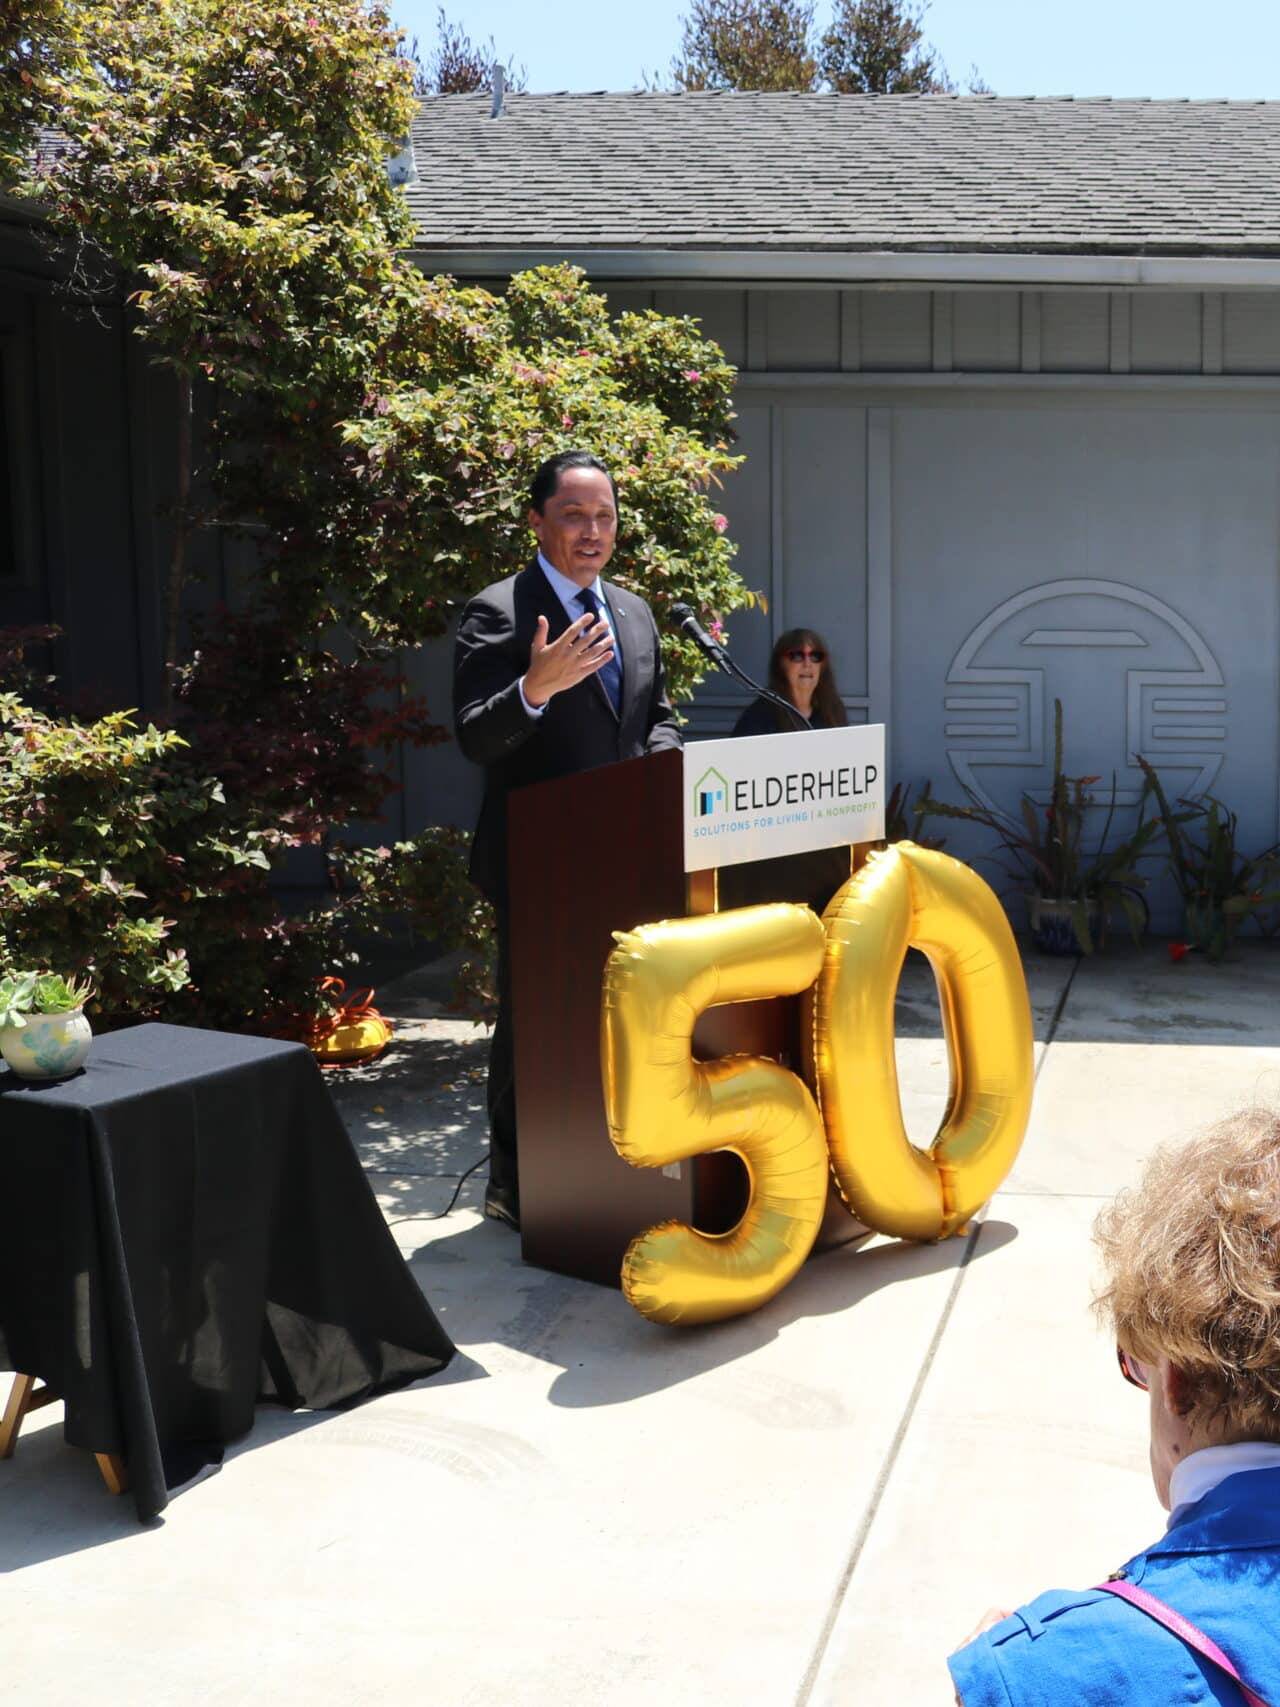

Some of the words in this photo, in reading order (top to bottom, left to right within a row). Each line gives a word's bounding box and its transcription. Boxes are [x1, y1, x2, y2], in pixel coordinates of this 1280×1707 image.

[735, 765, 878, 812] ELDERHELP
[693, 821, 751, 837] SOLUTIONS
[753, 817, 773, 828] FOR
[776, 813, 808, 826] LIVING
[826, 801, 877, 817] NONPROFIT
[601, 840, 1035, 1326] 50
